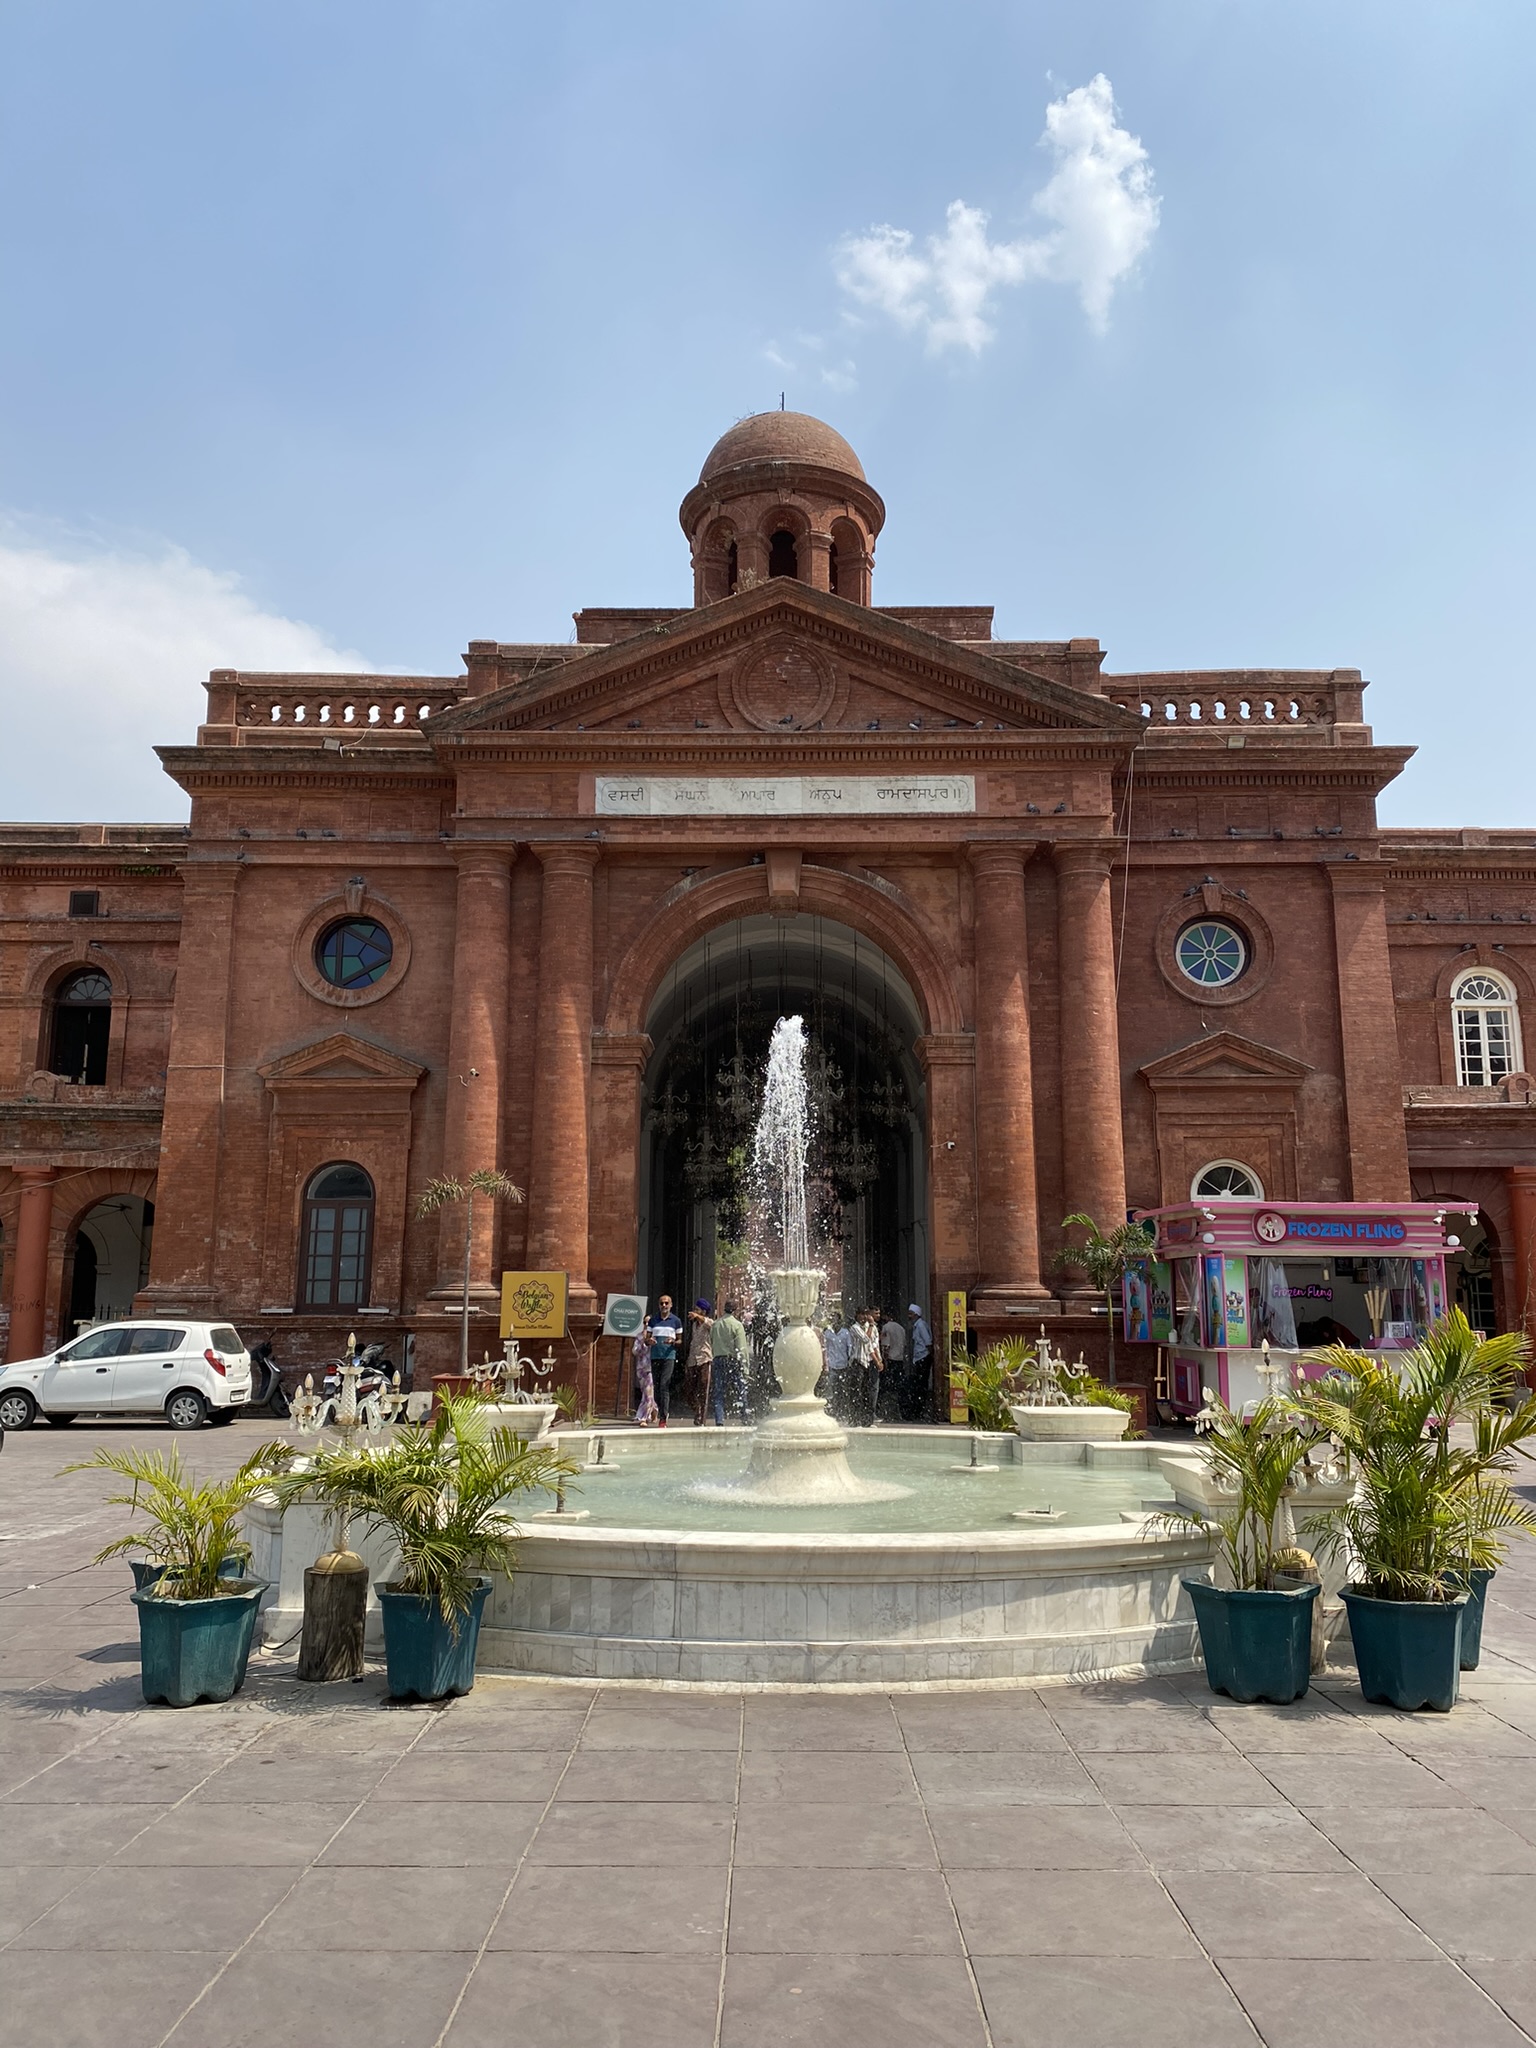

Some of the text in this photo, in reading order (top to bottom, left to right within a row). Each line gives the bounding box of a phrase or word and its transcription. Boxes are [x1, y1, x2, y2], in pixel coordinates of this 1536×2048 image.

[1287, 1222, 1405, 1239] FROZEN FLING
[1272, 1285, 1306, 1299] Frozen
